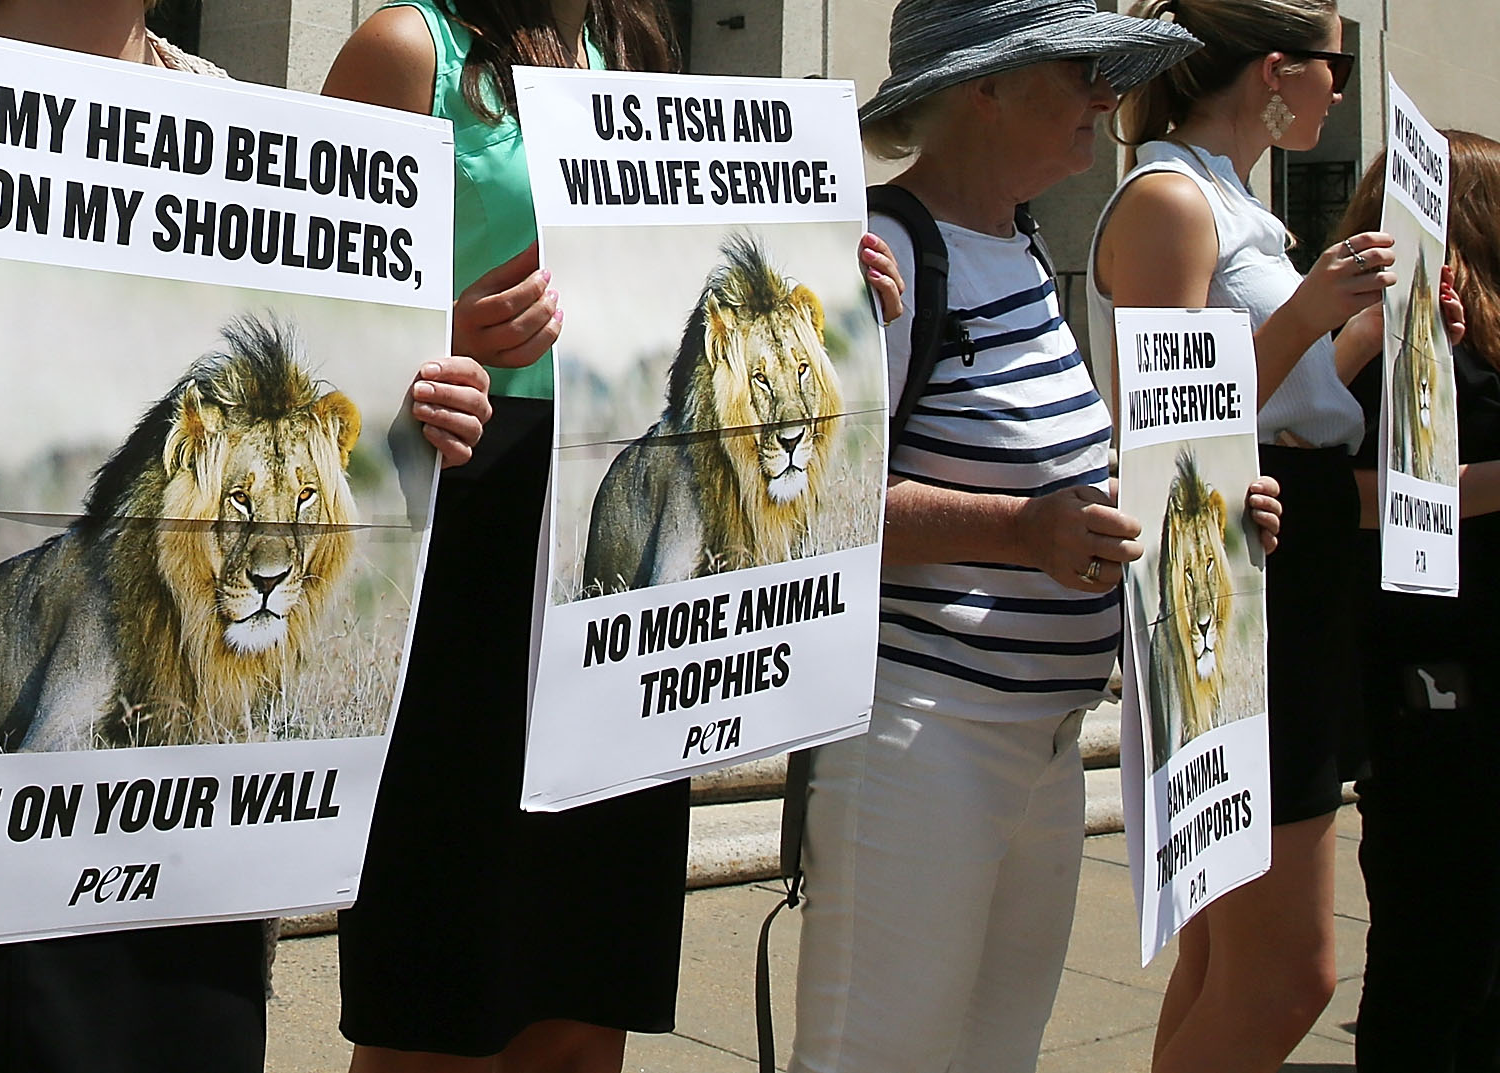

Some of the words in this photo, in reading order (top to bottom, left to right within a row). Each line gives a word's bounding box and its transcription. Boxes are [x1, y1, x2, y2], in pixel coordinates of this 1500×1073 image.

[591, 93, 652, 141] U.S.
[656, 96, 726, 143] FISH
[733, 99, 793, 143] AND
[1394, 105, 1405, 144] MY
[1405, 116, 1418, 160] HEAD
[86, 102, 213, 175] HEAD
[225, 126, 419, 209] BELONGS
[559, 158, 704, 205] WILDLIFE
[708, 159, 837, 206] SERVICE:
[1392, 149, 1402, 187] ON
[1401, 158, 1412, 196] MY
[63, 181, 144, 246] MY
[152, 194, 422, 290] SHOULDERS,
[1135, 332, 1152, 373] U.S.
[1153, 332, 1180, 371] FISH
[1183, 332, 1216, 369] AND
[1128, 387, 1170, 432] WILDLIFE
[1171, 382, 1241, 425] SERVICE:
[1389, 490, 1403, 526] NOT
[1404, 494, 1414, 528] ON
[1414, 498, 1431, 532] YOUR
[1431, 502, 1453, 536] WALL
[583, 613, 631, 668] NO
[637, 593, 731, 657] MORE
[734, 572, 845, 636] ANIMAL
[640, 642, 791, 719] TROPHIES
[7, 783, 83, 842] ON
[93, 776, 219, 835] YOUR
[230, 768, 340, 826] WALL
[1167, 769, 1185, 823] BAN
[1186, 745, 1229, 803] ANIMAL
[1156, 823, 1193, 892] TROPHY
[1193, 789, 1252, 857] IMPORTS
